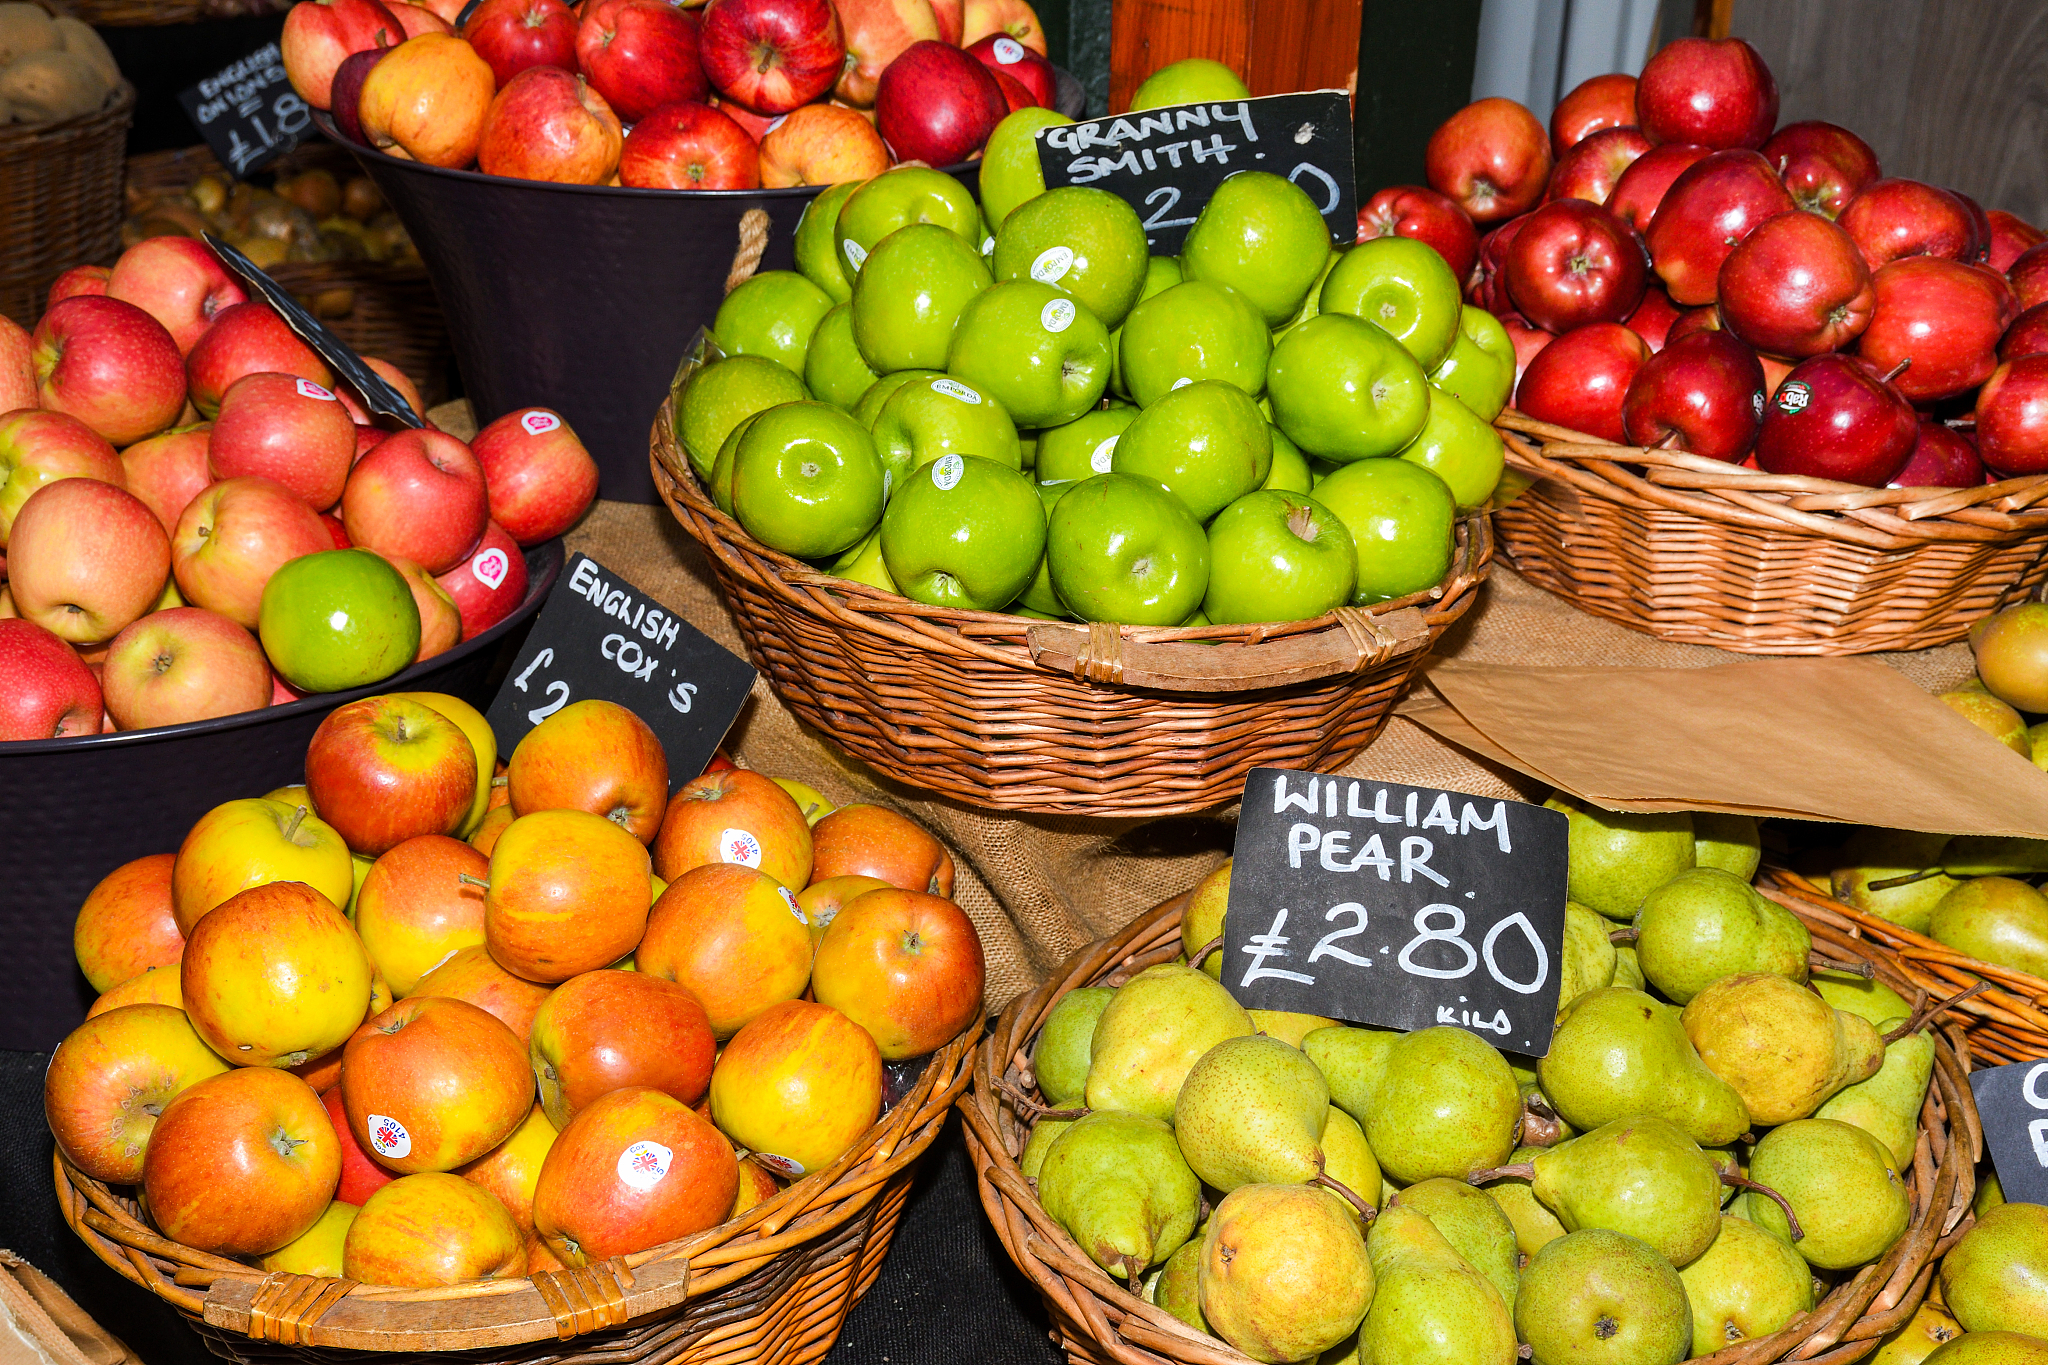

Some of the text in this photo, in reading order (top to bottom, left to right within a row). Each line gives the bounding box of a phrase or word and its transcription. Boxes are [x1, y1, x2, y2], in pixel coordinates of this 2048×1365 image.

[1047, 102, 1258, 154] GRANNY
[569, 558, 680, 651] ENGLISH
[1273, 774, 1511, 854] WILLIAM
[1241, 902, 1549, 994] £2.80
[383, 1118, 405, 1139] 4105
[630, 1144, 645, 1154] Cox
